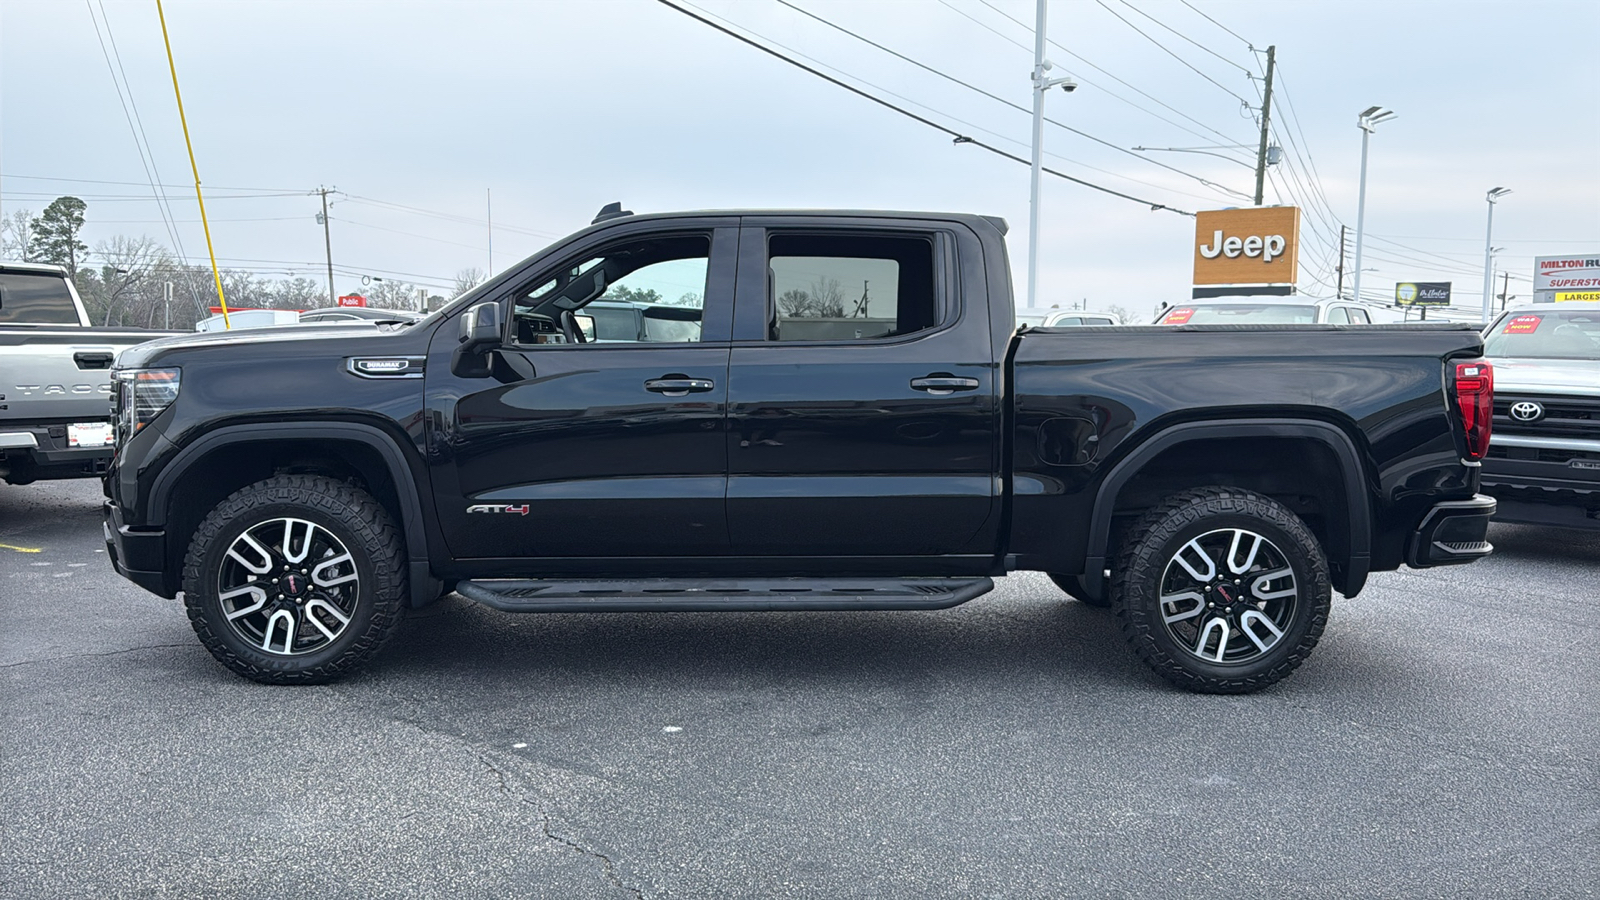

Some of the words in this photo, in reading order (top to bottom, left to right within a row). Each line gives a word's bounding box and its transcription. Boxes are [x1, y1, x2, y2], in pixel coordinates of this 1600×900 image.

[1199, 230, 1286, 262] Jeep
[1540, 259, 1584, 269] MILTON
[466, 504, 530, 516] AT4
[288, 574, 298, 594] GMC
[1216, 585, 1232, 602] GMC
